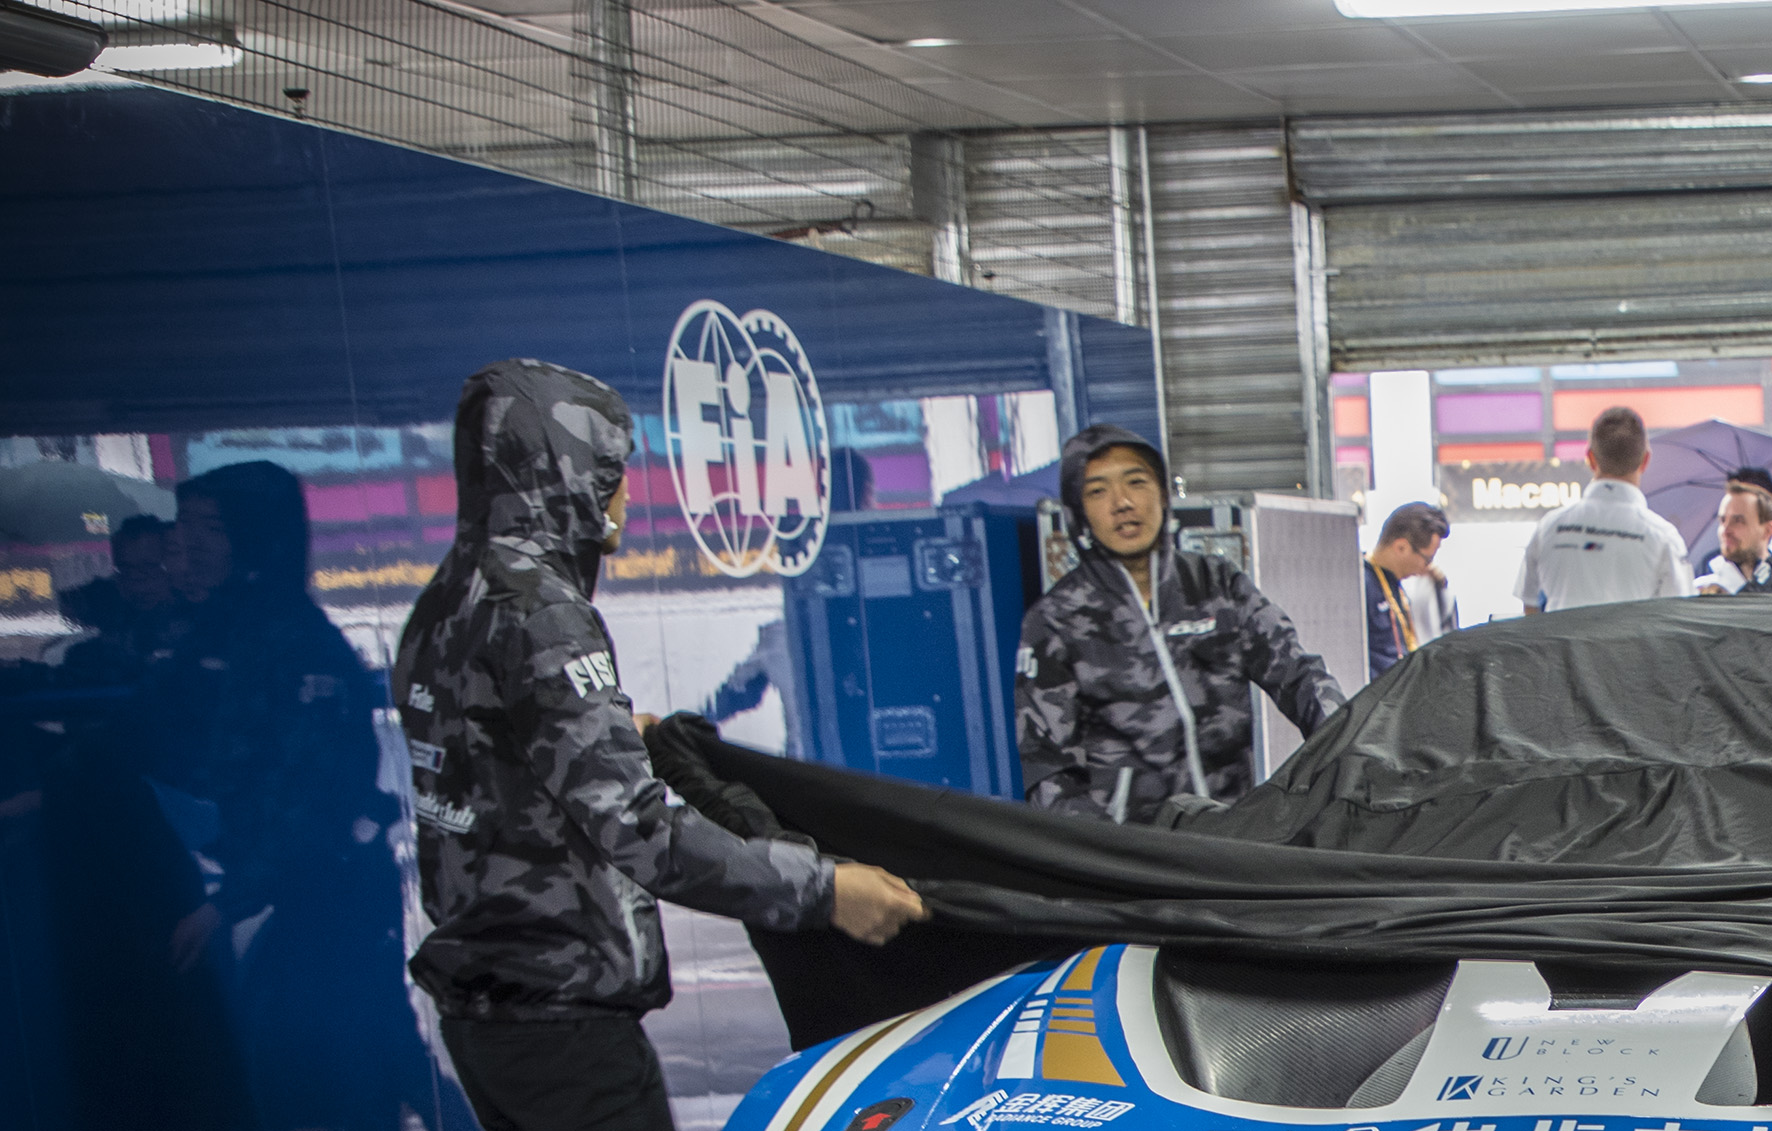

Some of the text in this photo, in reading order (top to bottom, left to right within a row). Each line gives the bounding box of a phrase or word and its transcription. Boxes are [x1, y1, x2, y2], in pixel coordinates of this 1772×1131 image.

[1472, 476, 1582, 510] Macau
[1491, 1075, 1638, 1086] KING'S
[1487, 1085, 1662, 1098] GARDEN
[1052, 1116, 1103, 1129] GROUP
